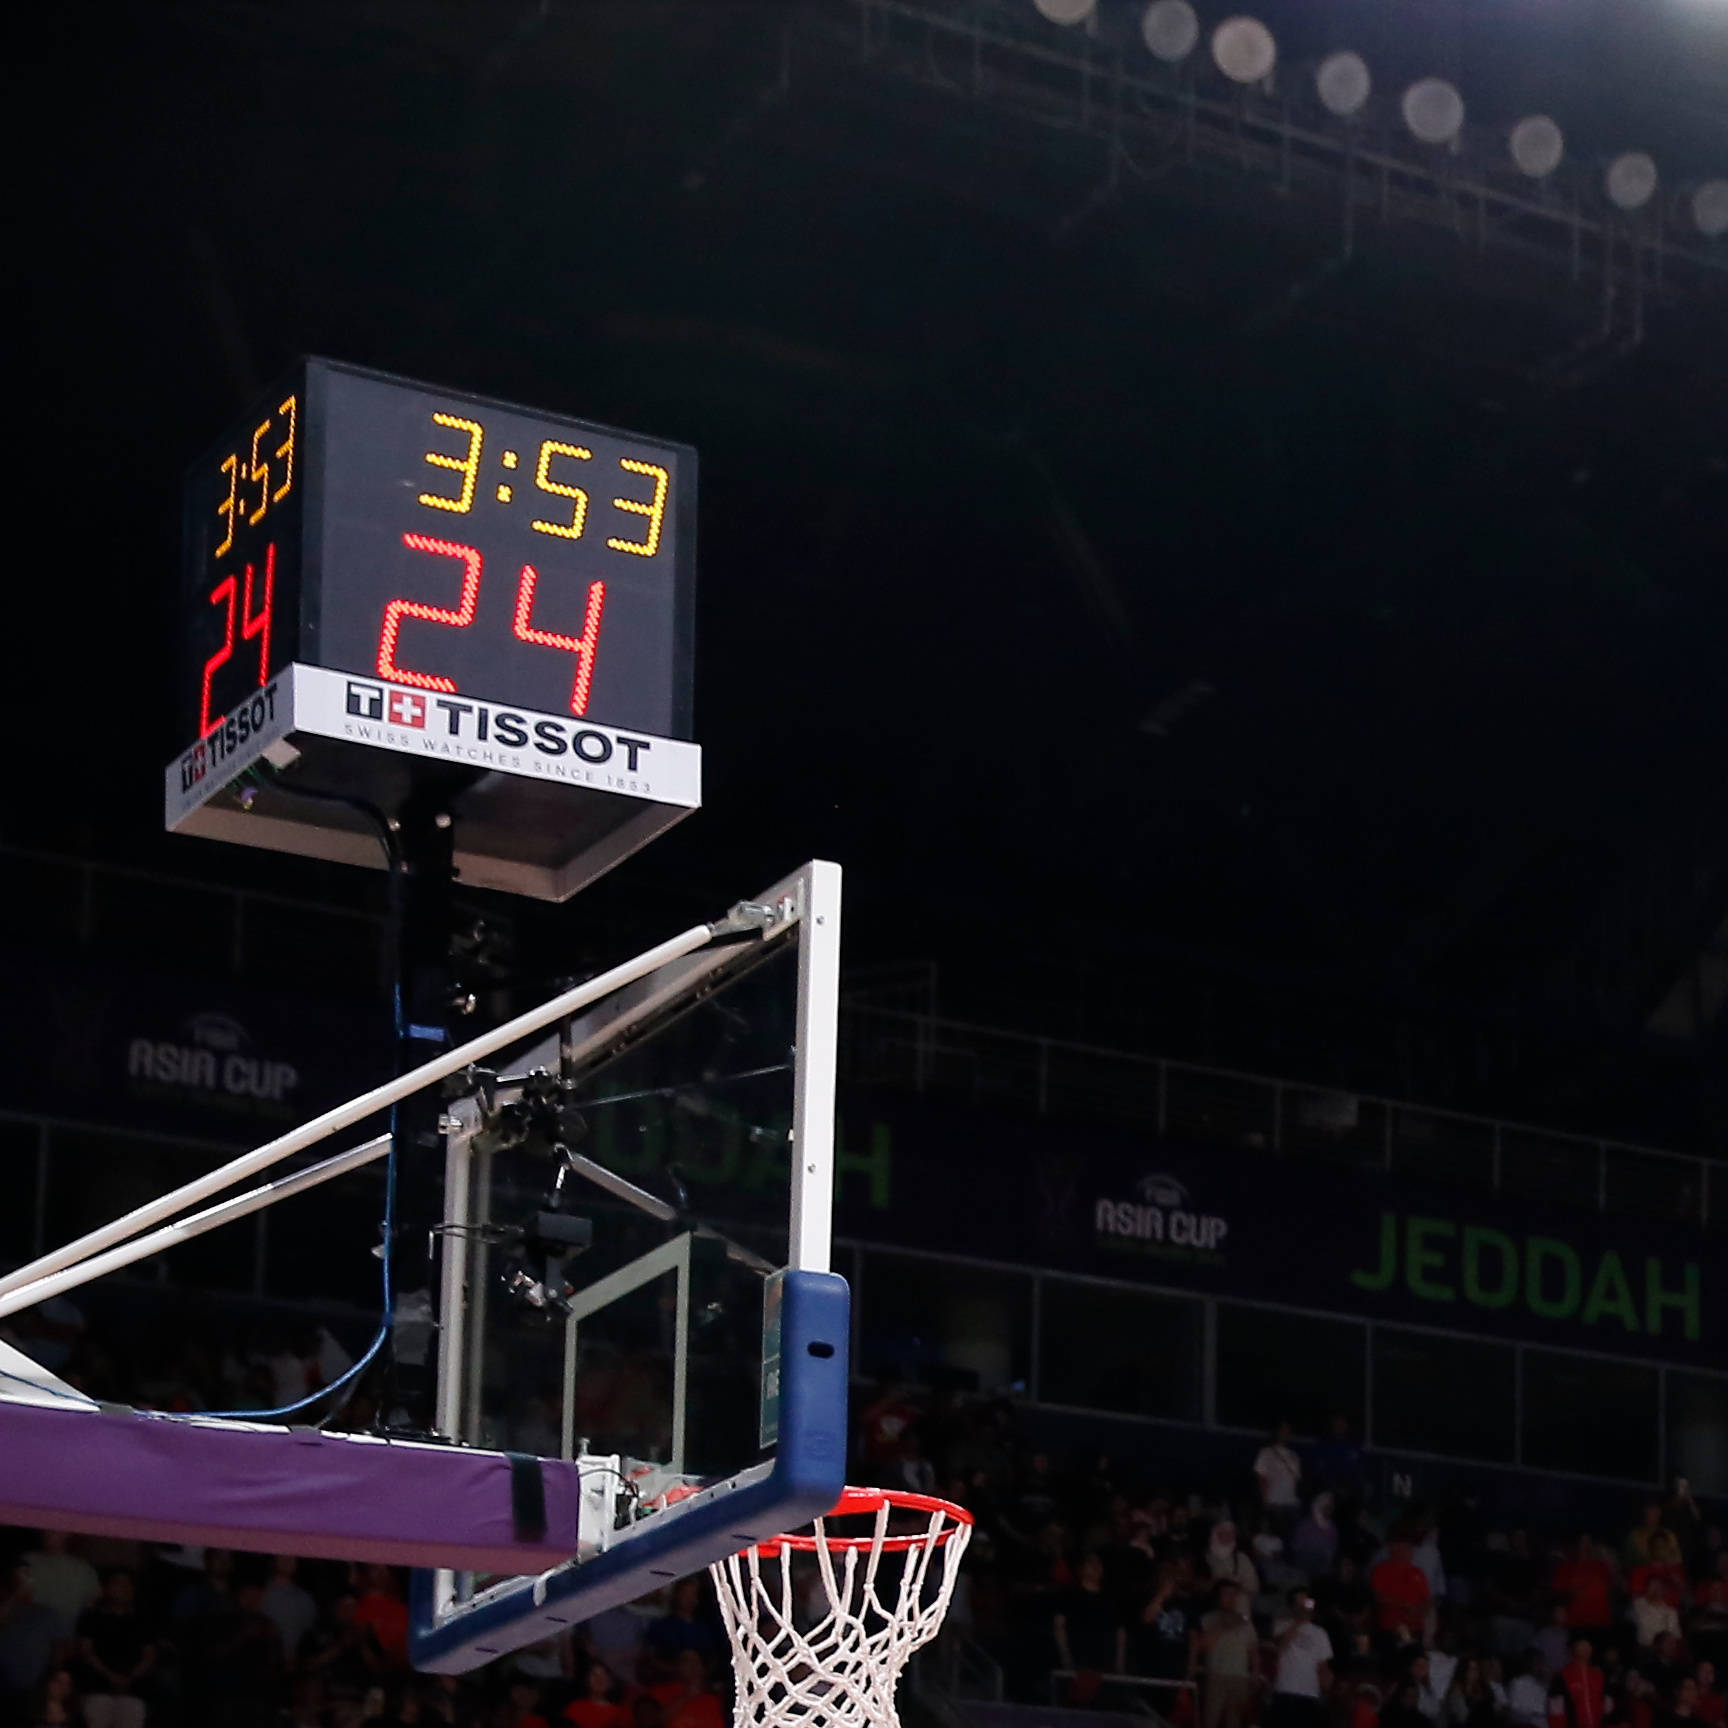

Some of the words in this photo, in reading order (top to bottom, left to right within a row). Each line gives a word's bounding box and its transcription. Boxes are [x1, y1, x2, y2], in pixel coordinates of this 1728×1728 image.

[215, 395, 297, 558] 3:53
[417, 411, 670, 557] 3:53
[200, 542, 277, 738] 24
[376, 533, 605, 716] 24
[207, 683, 278, 767] TISSOT
[343, 723, 411, 748] SWISS
[422, 737, 522, 769] WATCHES
[532, 759, 597, 783] SINCE
[436, 698, 651, 772] TISSOT
[128, 1036, 216, 1091] ASIA
[222, 1053, 299, 1101] CUP
[1095, 1196, 1164, 1243] ASIA
[1168, 1208, 1229, 1251] CUP
[1349, 1210, 1702, 1342] JEDDAH
